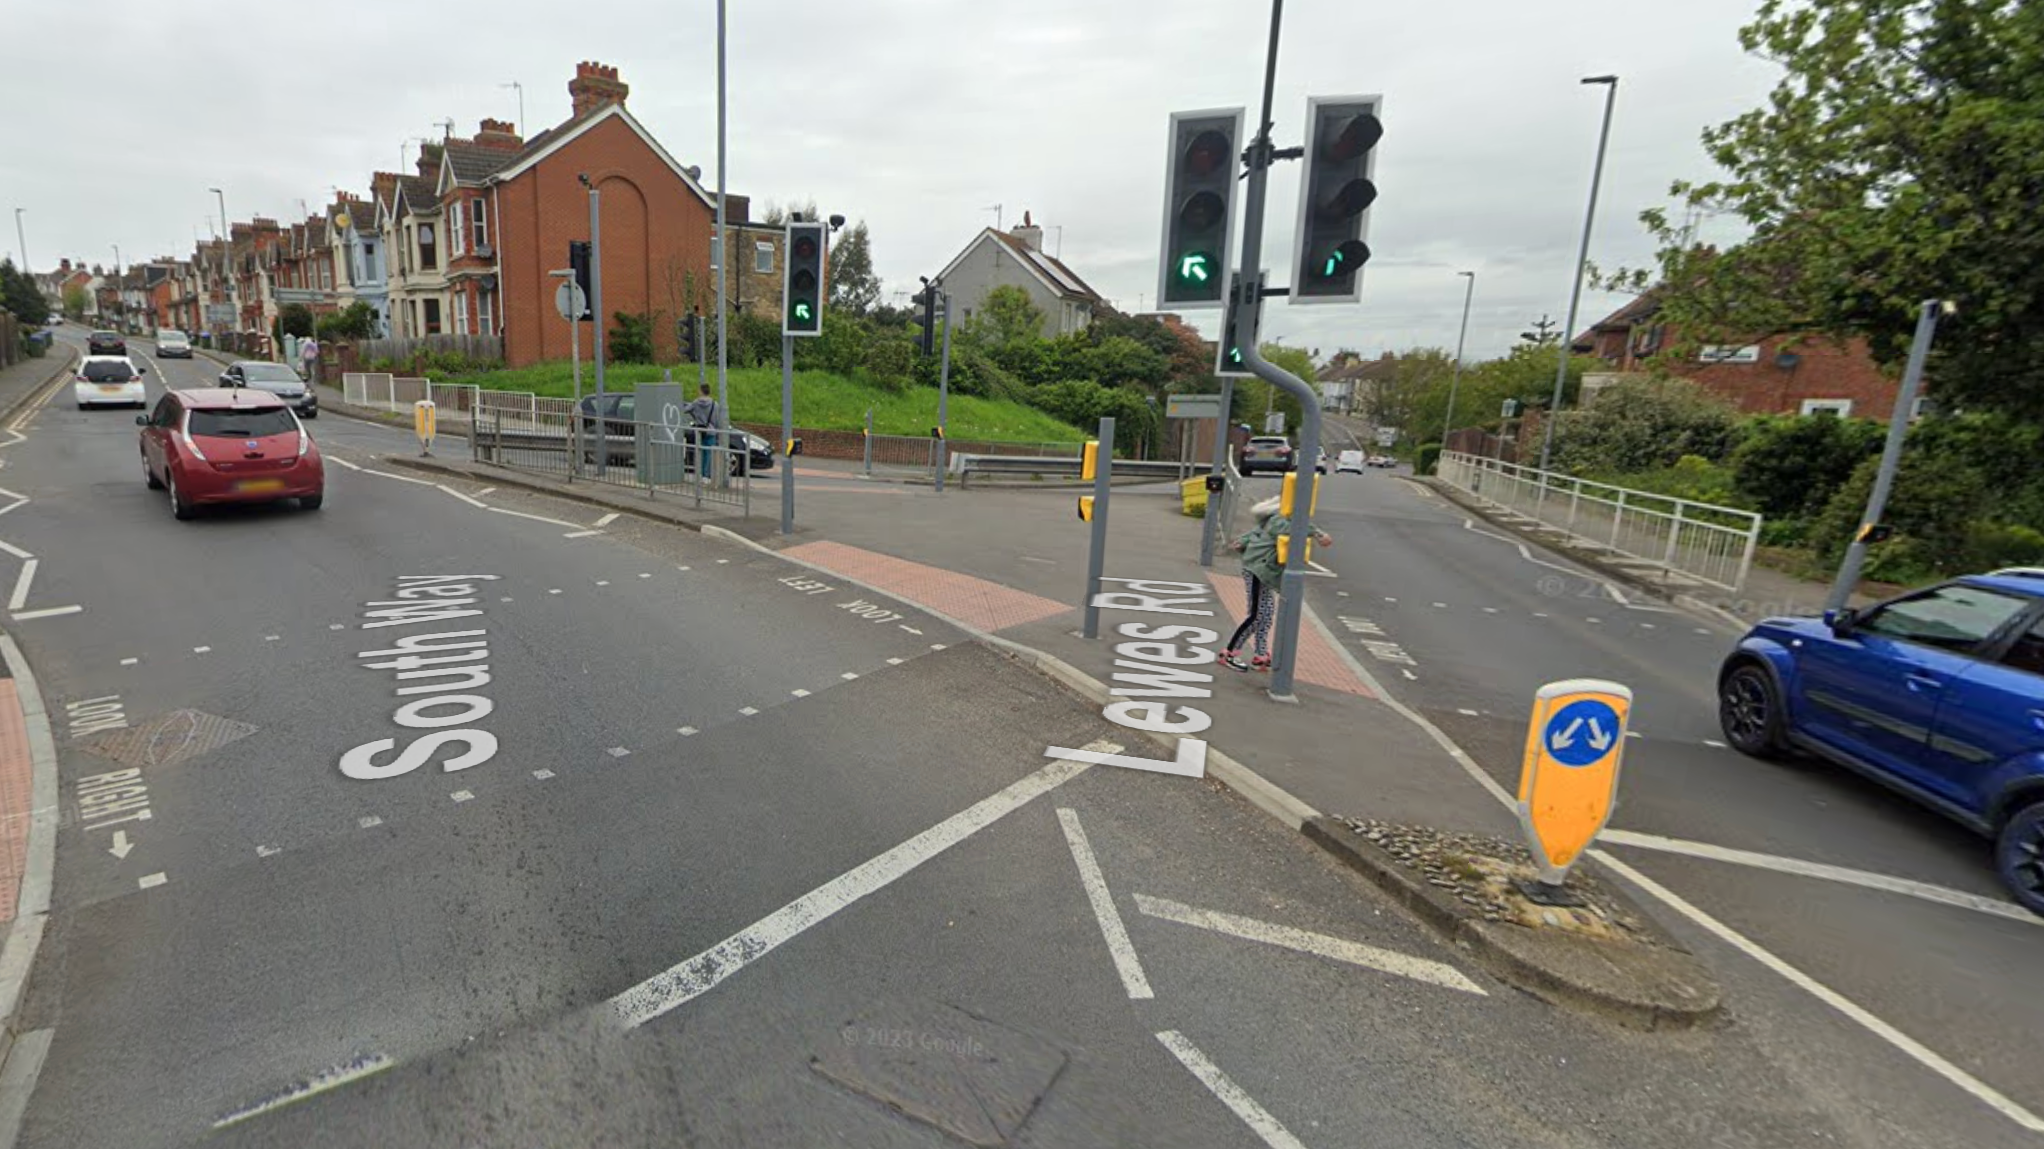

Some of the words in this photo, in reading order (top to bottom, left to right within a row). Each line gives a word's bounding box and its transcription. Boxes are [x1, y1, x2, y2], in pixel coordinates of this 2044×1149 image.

[777, 575, 835, 595] LEFT
[836, 599, 904, 623] LOOK
[66, 694, 128, 739] LOOK
[76, 767, 152, 831] RIGHT
